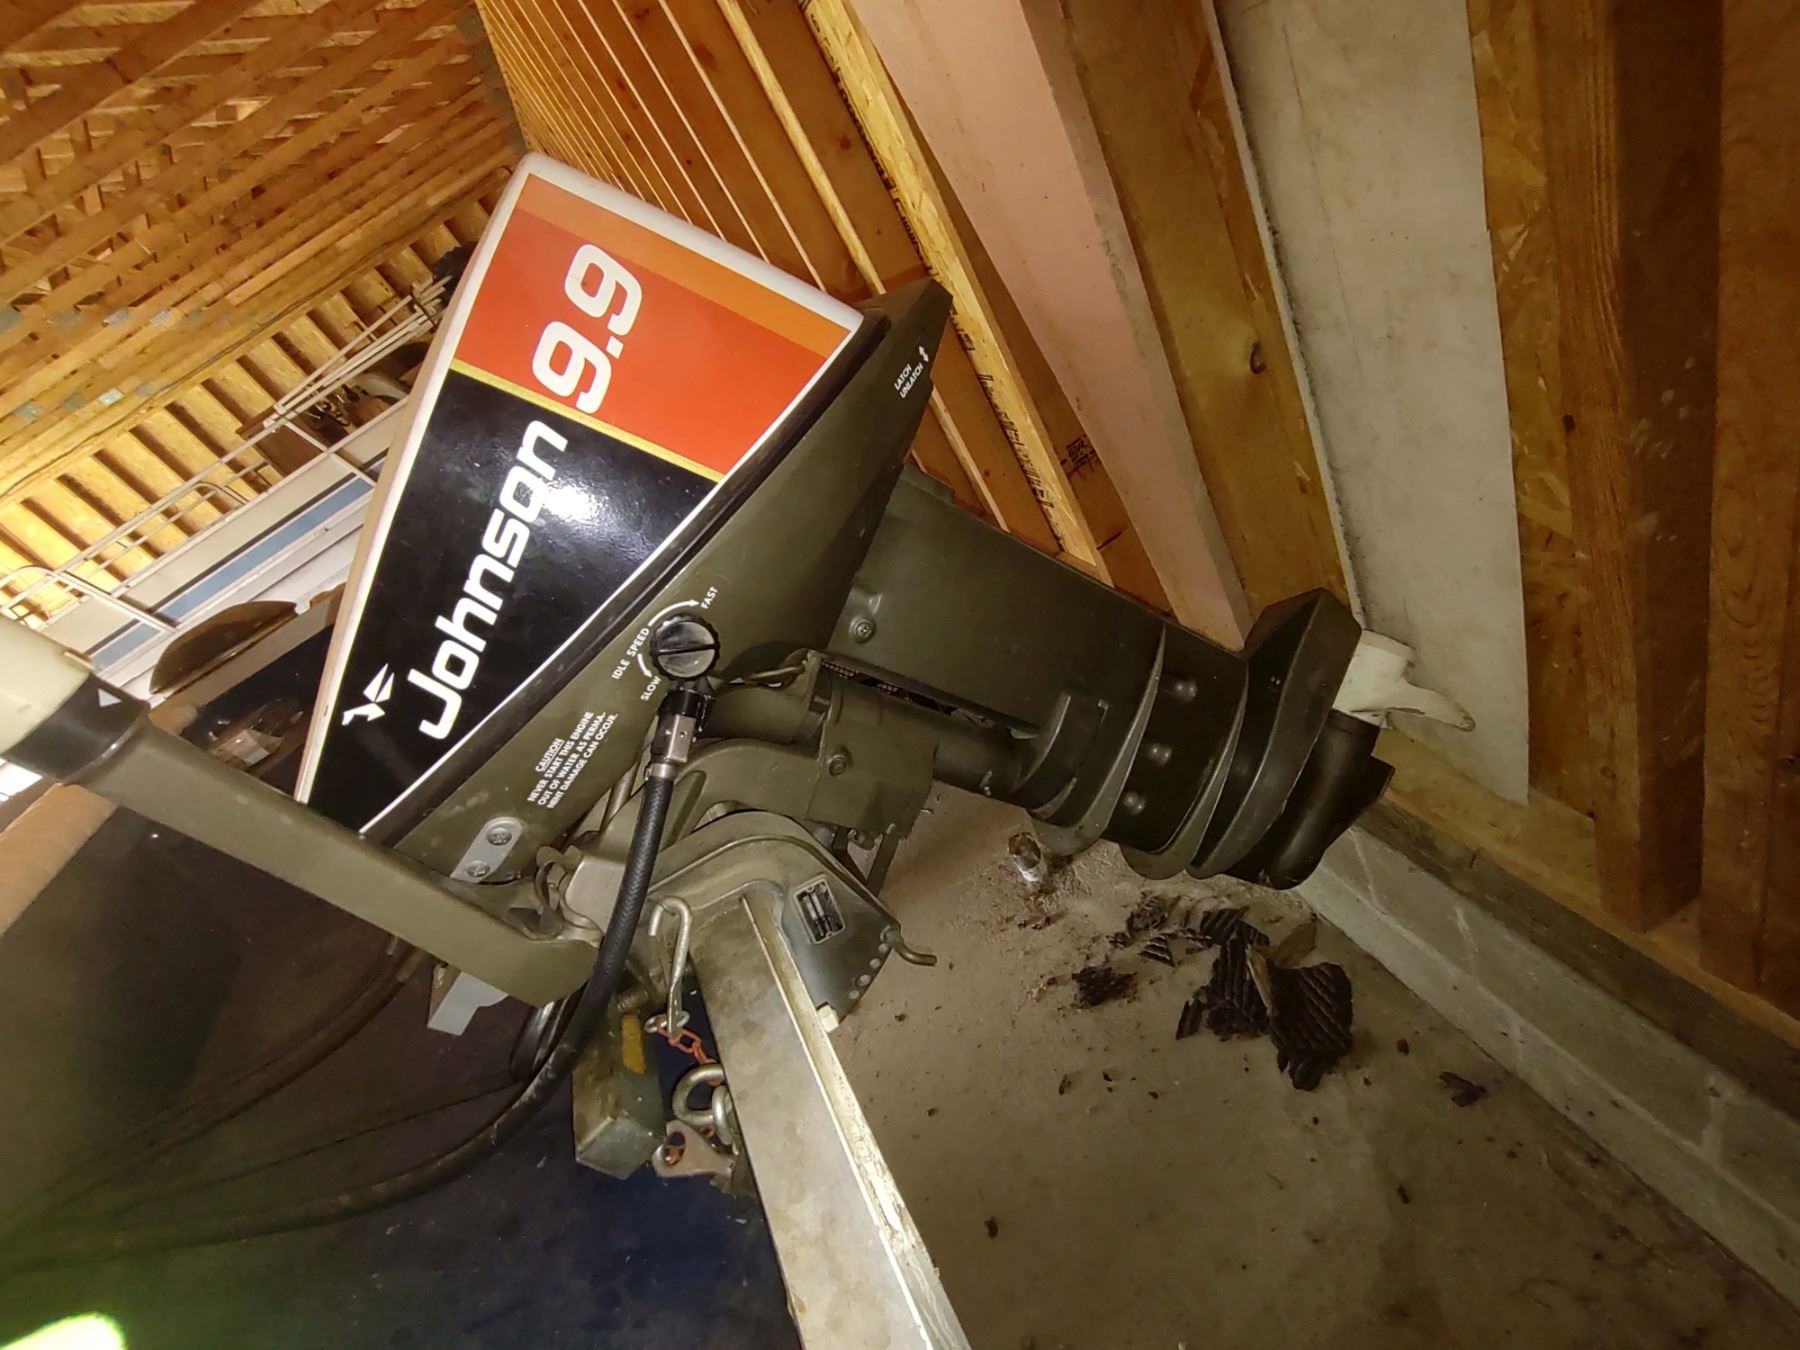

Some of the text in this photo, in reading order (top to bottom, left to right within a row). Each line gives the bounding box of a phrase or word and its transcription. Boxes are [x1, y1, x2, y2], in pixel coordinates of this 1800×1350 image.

[533, 244, 642, 414] 9.9
[893, 363, 912, 390] LATCH
[899, 362, 924, 399] UNLATCH
[407, 420, 568, 740] Johnson
[700, 586, 719, 609] FAST
[612, 627, 650, 680] IDLE SPEED
[640, 675, 662, 701] SLOW
[527, 711, 594, 802] NEVER START THIS ENGINE
[535, 737, 565, 771] CAUTION
[537, 788, 553, 805] OUT
[549, 777, 561, 790] OF
[556, 751, 580, 778] WATER
[577, 740, 587, 752] AS
[547, 789, 564, 808] NENT
[561, 758, 588, 790] DAMAGE
[584, 740, 599, 758] CAN
